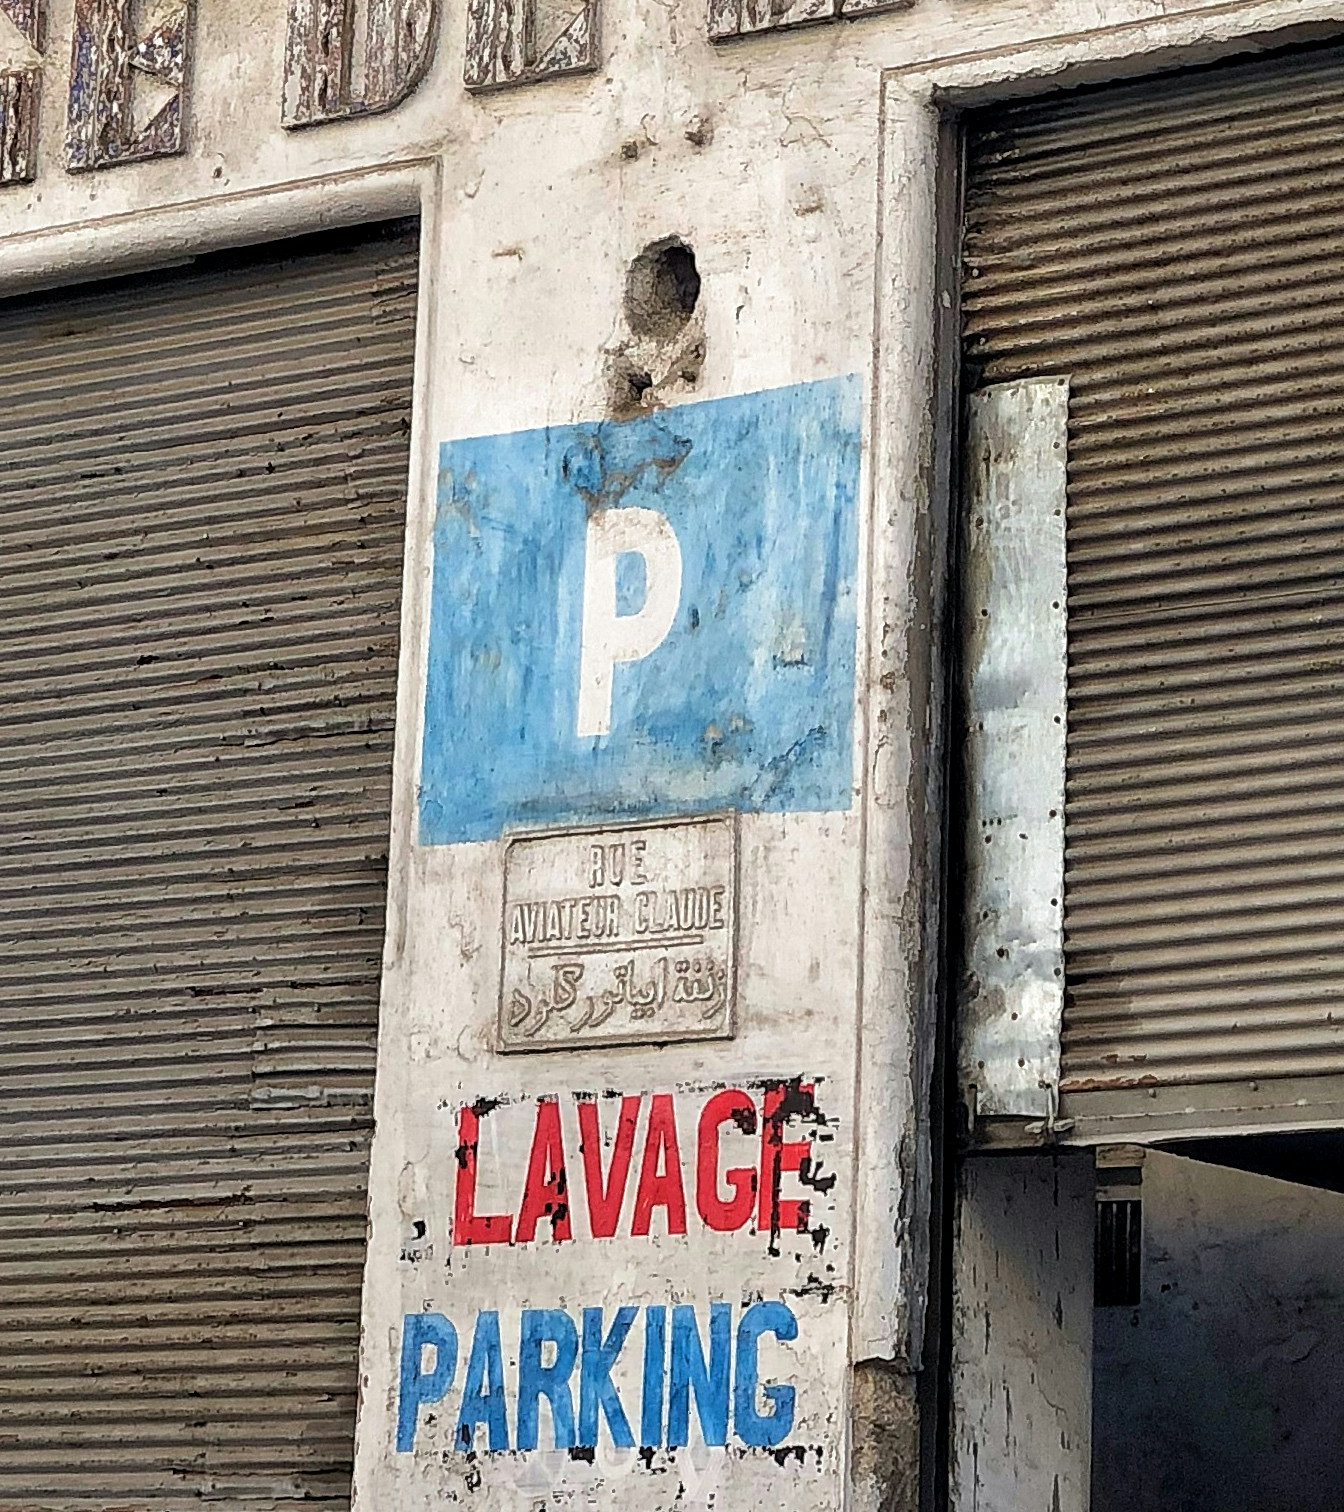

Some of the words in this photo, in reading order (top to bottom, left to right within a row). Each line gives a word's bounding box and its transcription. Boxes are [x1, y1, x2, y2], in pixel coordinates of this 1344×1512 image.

[576, 506, 683, 737] P
[509, 893, 621, 945] AVIATEUR
[632, 885, 726, 936] CLAUDE
[588, 839, 650, 889] RUE
[452, 1080, 820, 1247] LAVAGE
[395, 1300, 800, 1454] PARKING
